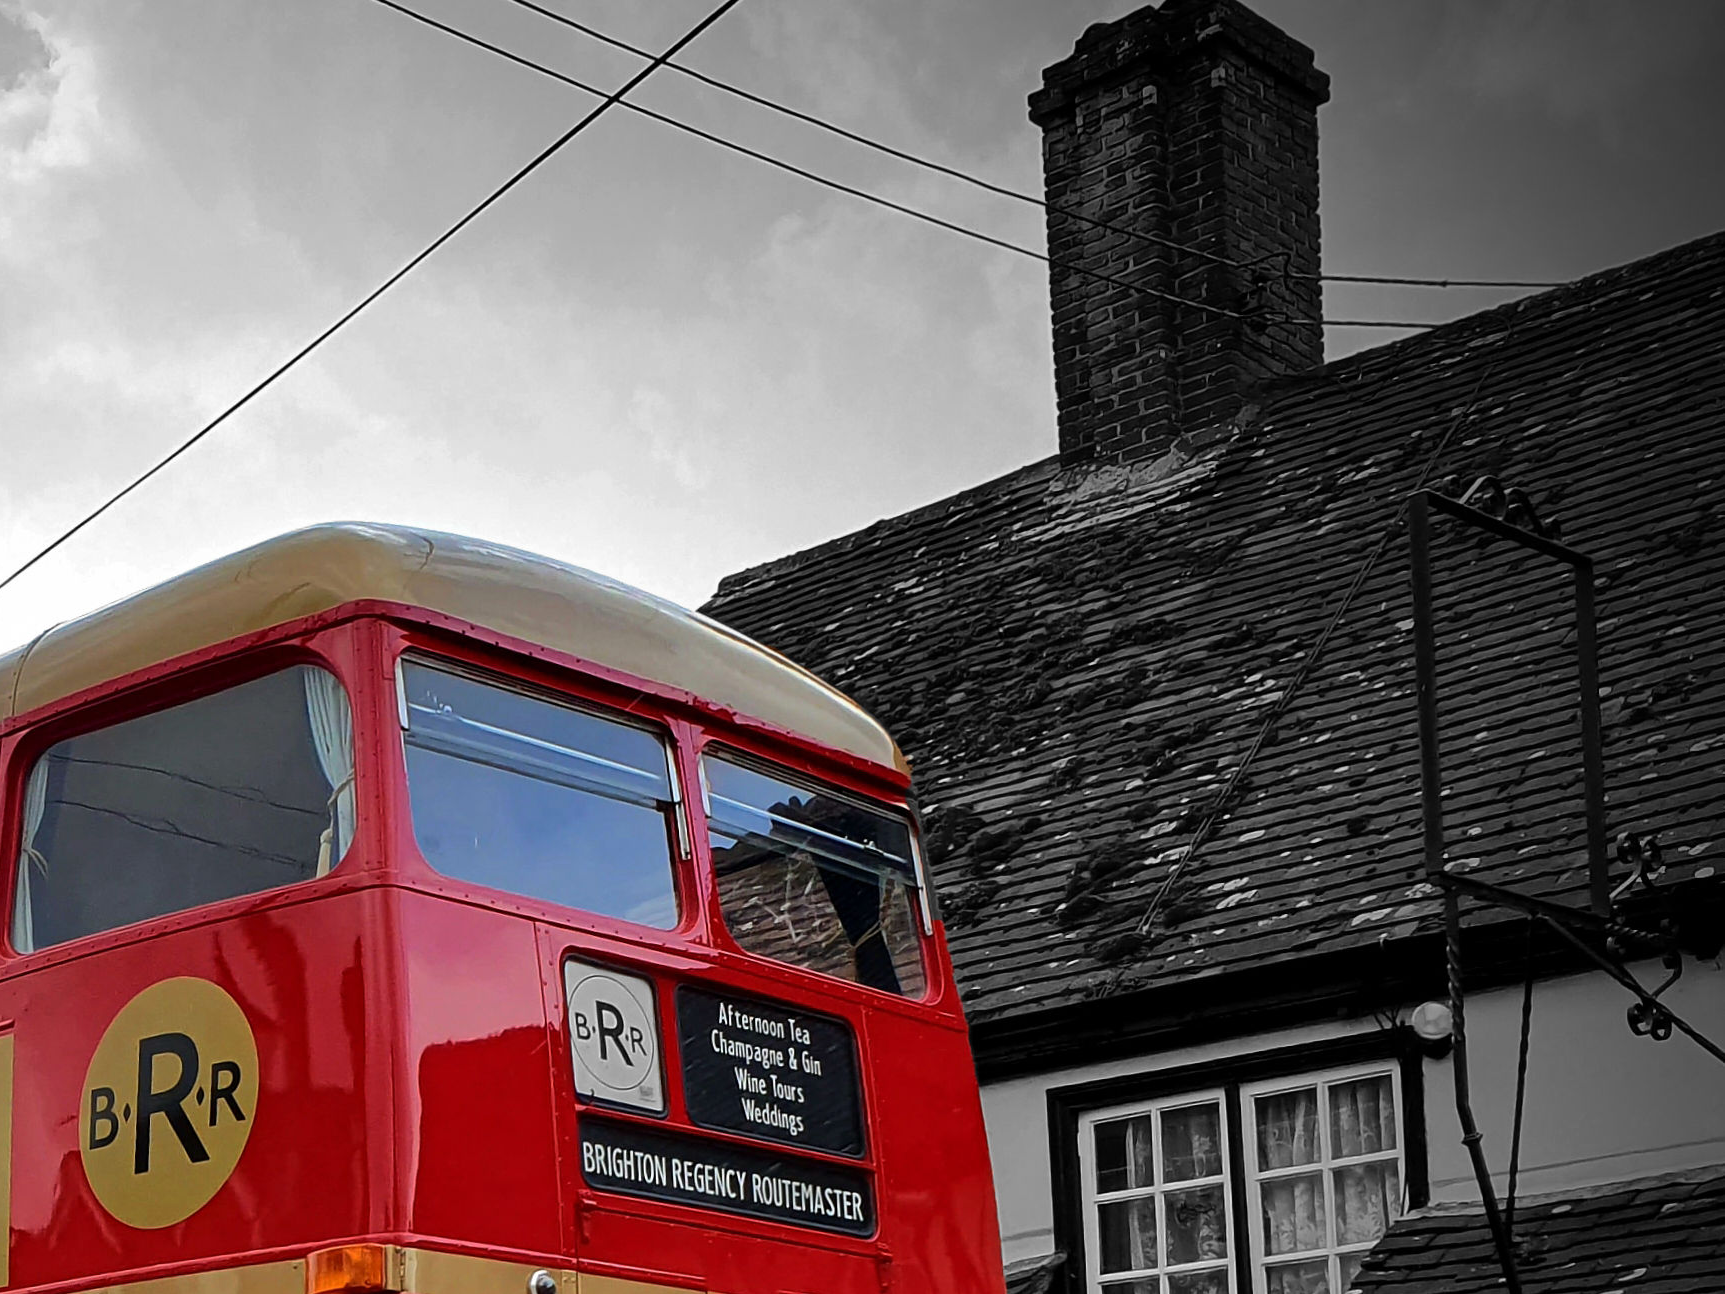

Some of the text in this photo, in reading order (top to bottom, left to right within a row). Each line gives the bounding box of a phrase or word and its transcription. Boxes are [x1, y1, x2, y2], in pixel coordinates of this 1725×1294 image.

[718, 1003, 811, 1045] Afternoon Tea
[712, 1029, 822, 1076] Champagne & Gin
[735, 1067, 805, 1103] Wine Tours
[742, 1098, 805, 1136] Weddings
[582, 1141, 864, 1222] BRIGHTON REGENCY ROUTEMASTER
